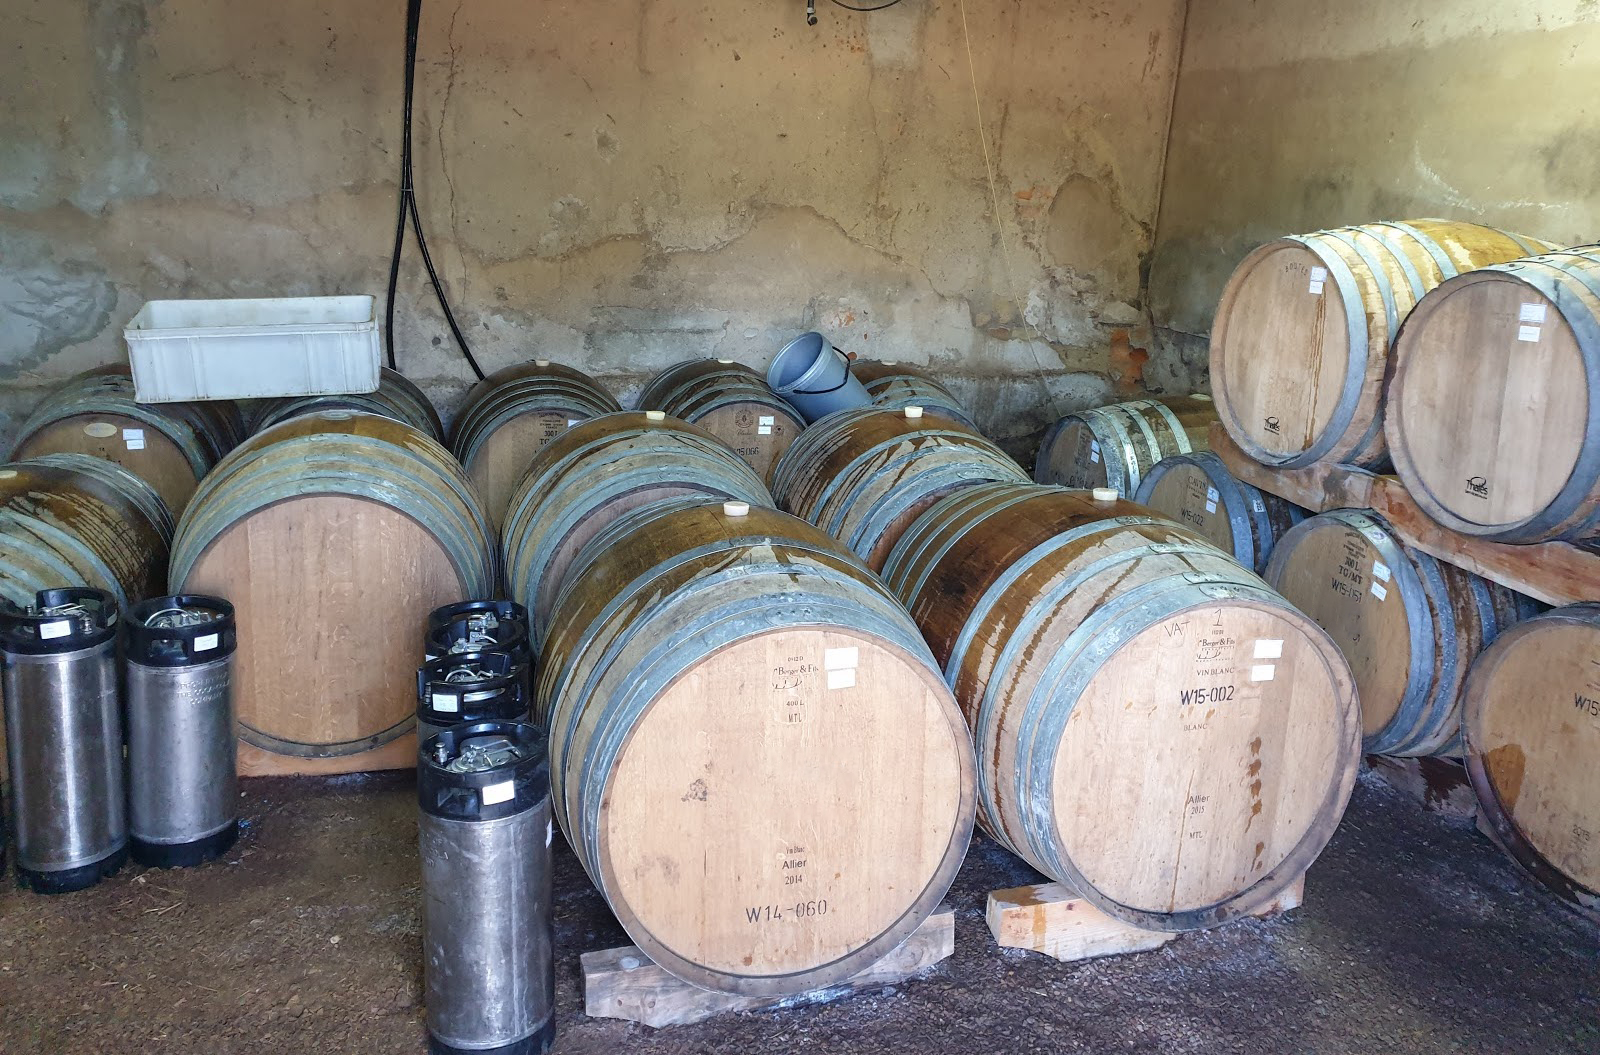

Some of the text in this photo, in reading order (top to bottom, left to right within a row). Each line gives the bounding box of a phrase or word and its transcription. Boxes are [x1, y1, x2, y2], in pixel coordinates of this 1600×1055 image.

[1163, 620, 1191, 638] VAT
[1180, 684, 1235, 706] W15-002
[1574, 692, 1600, 717] W15
[1183, 722, 1208, 732] BLANC
[1188, 794, 1211, 805] Allier
[781, 859, 808, 871] Allier
[784, 874, 803, 885] 2014
[745, 899, 828, 924] W14-060
